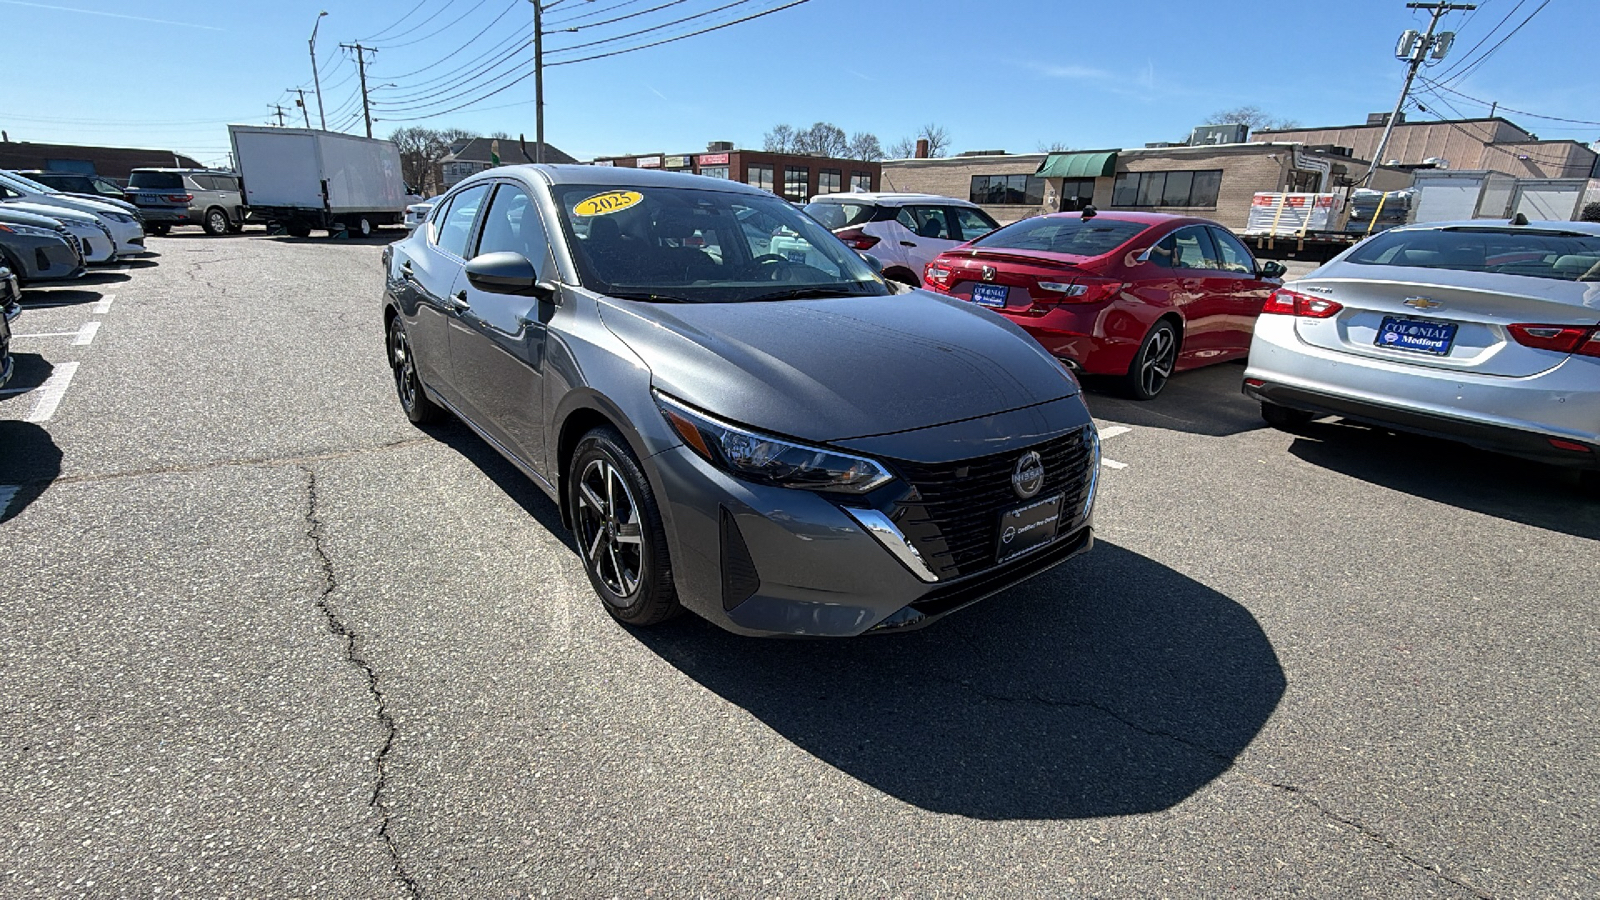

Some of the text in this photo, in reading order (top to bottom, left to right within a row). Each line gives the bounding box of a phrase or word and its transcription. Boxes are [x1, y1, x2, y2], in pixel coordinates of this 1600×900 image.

[587, 192, 632, 214] 2025
[1384, 323, 1449, 339] COLONIAL
[1401, 335, 1443, 348] Medford
[1014, 467, 1044, 482] NISSAN
